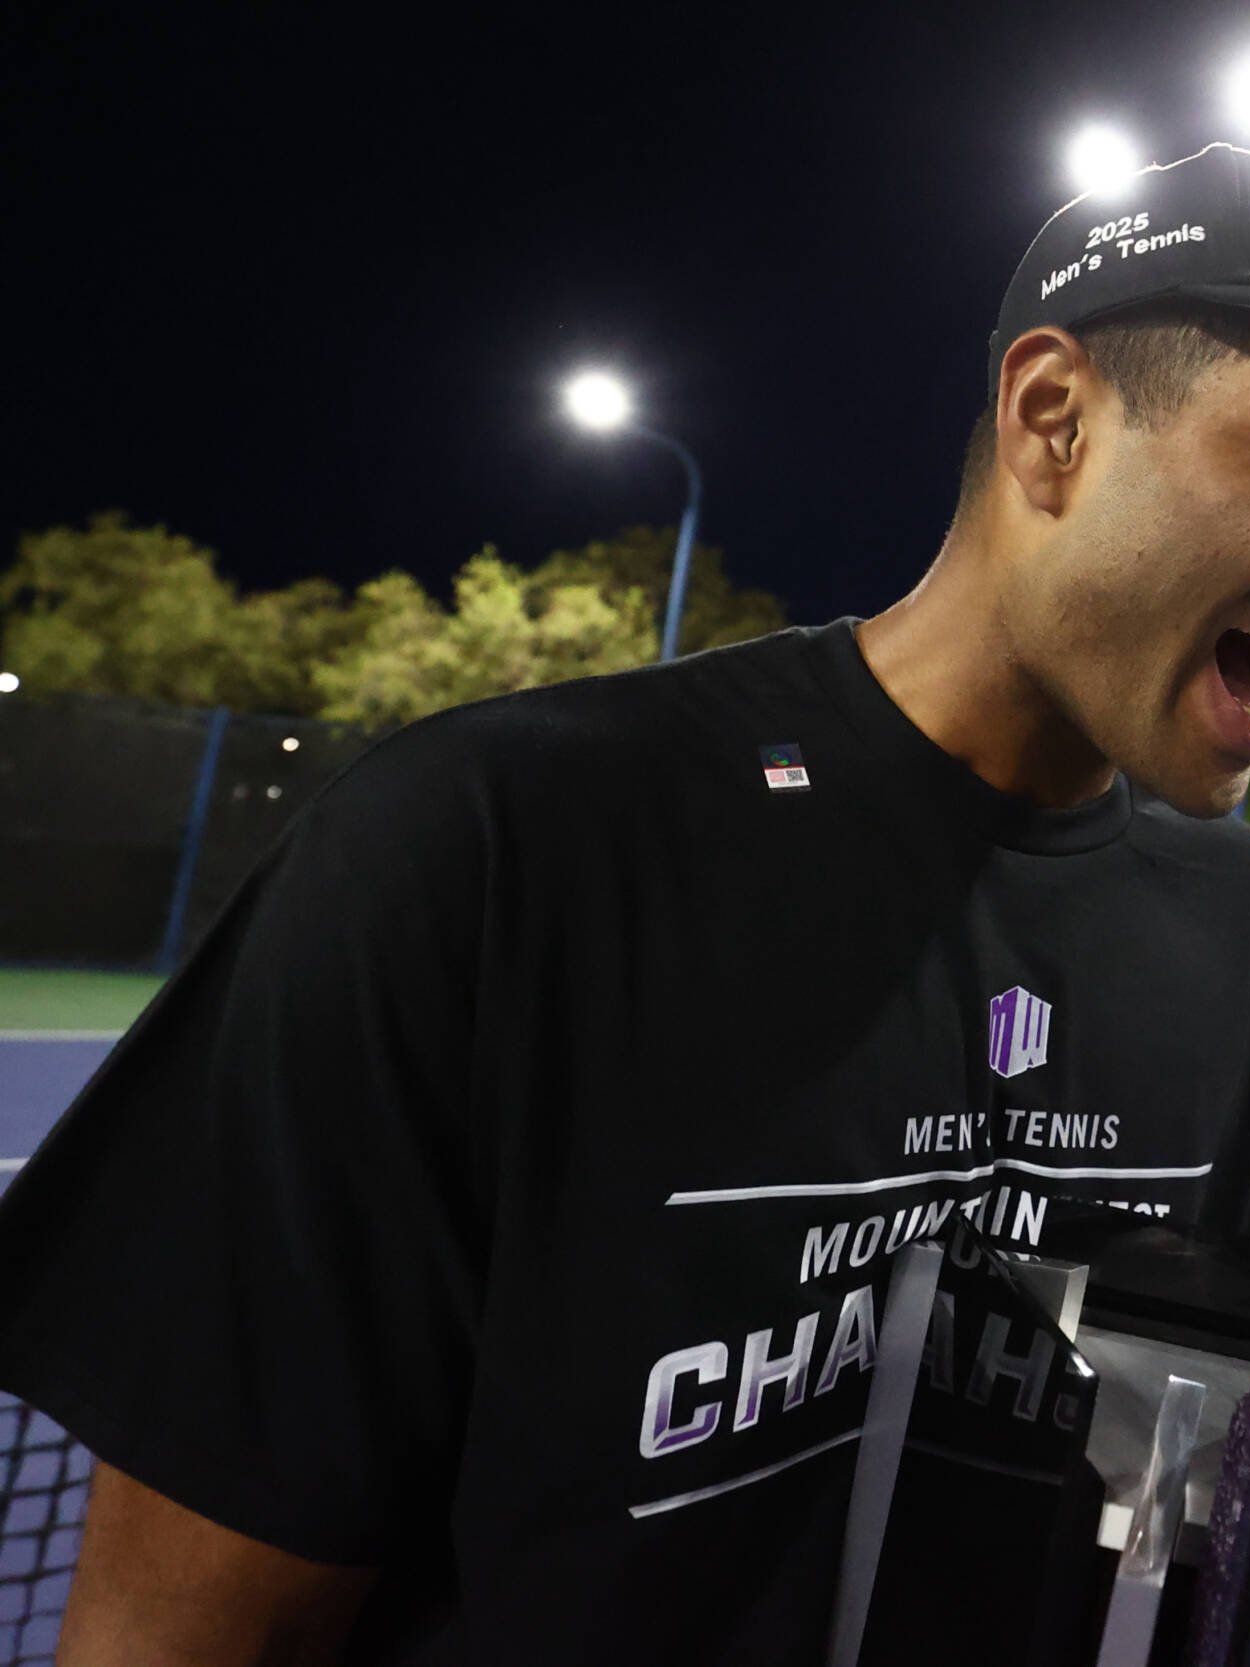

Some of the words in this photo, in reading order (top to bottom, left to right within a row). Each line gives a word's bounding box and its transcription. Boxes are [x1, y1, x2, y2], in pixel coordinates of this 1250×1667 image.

[1042, 254, 1102, 300] Men's
[1117, 223, 1206, 259] Tennis
[1085, 212, 1149, 249] 2025
[904, 1112, 991, 1155] MEN'
[1004, 1108, 1120, 1150] TENNIS
[640, 1284, 878, 1460] CHA
